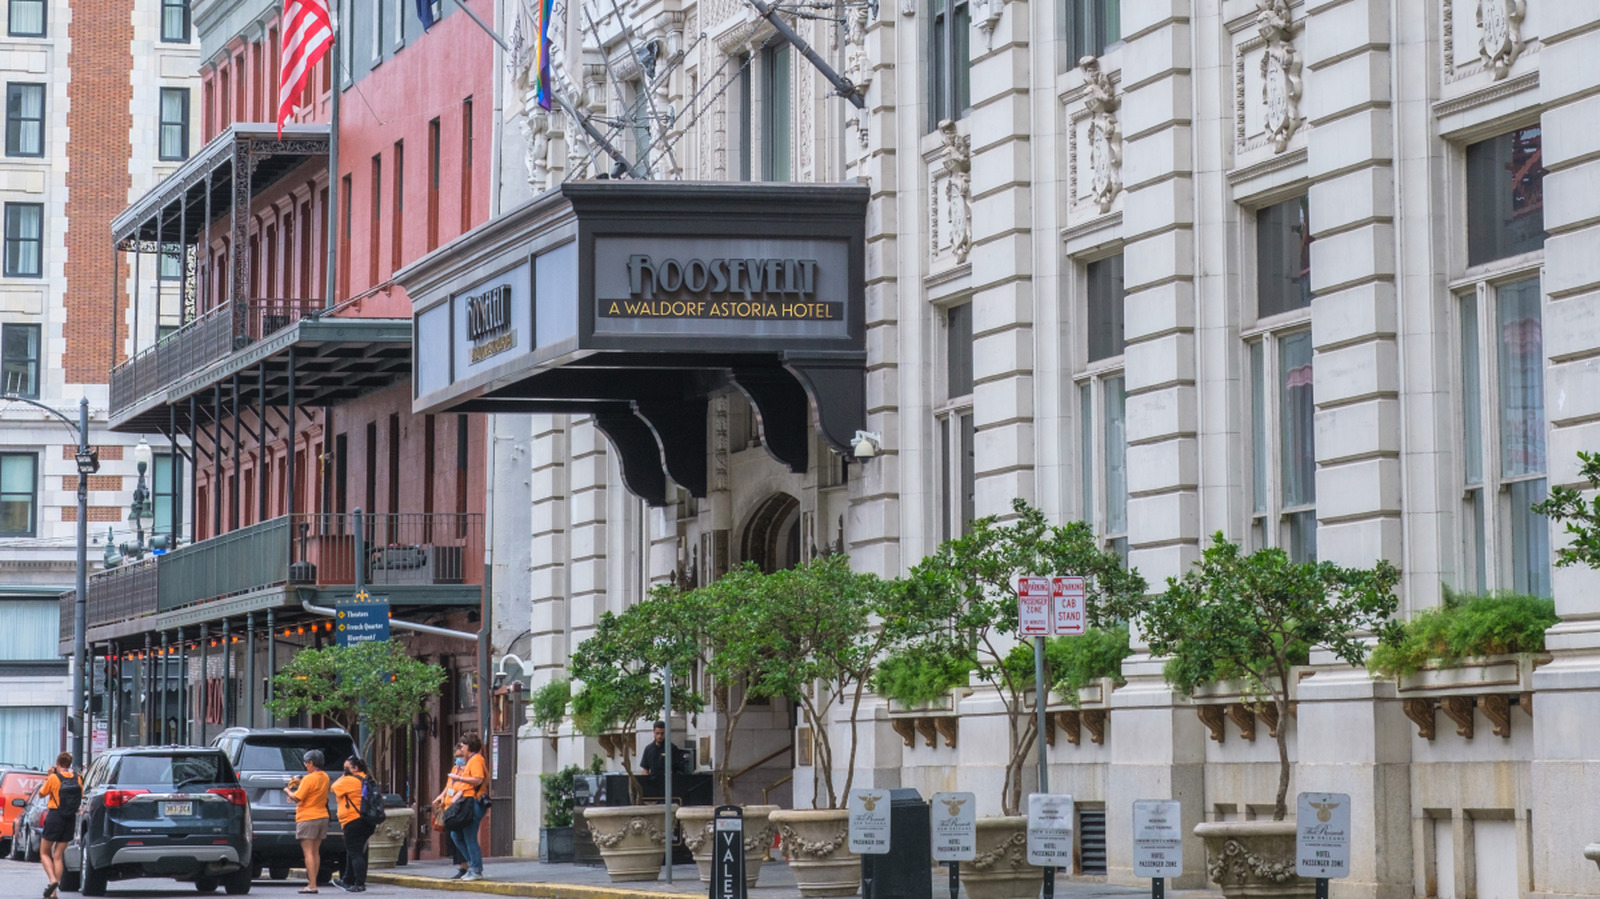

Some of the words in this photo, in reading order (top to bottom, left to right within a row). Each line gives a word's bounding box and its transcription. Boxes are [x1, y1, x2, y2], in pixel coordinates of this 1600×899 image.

[627, 254, 818, 295] ROOSEVELT
[608, 301, 620, 316] A
[624, 301, 705, 316] WALDORF
[709, 302, 778, 317] ASTORIA
[782, 303, 833, 318] HOTEL
[1053, 582, 1063, 593] NO
[1062, 583, 1084, 591] PARKING
[1062, 598, 1077, 609] CAB
[1058, 611, 1081, 621] STAND
[364, 623, 384, 631] Quarter
